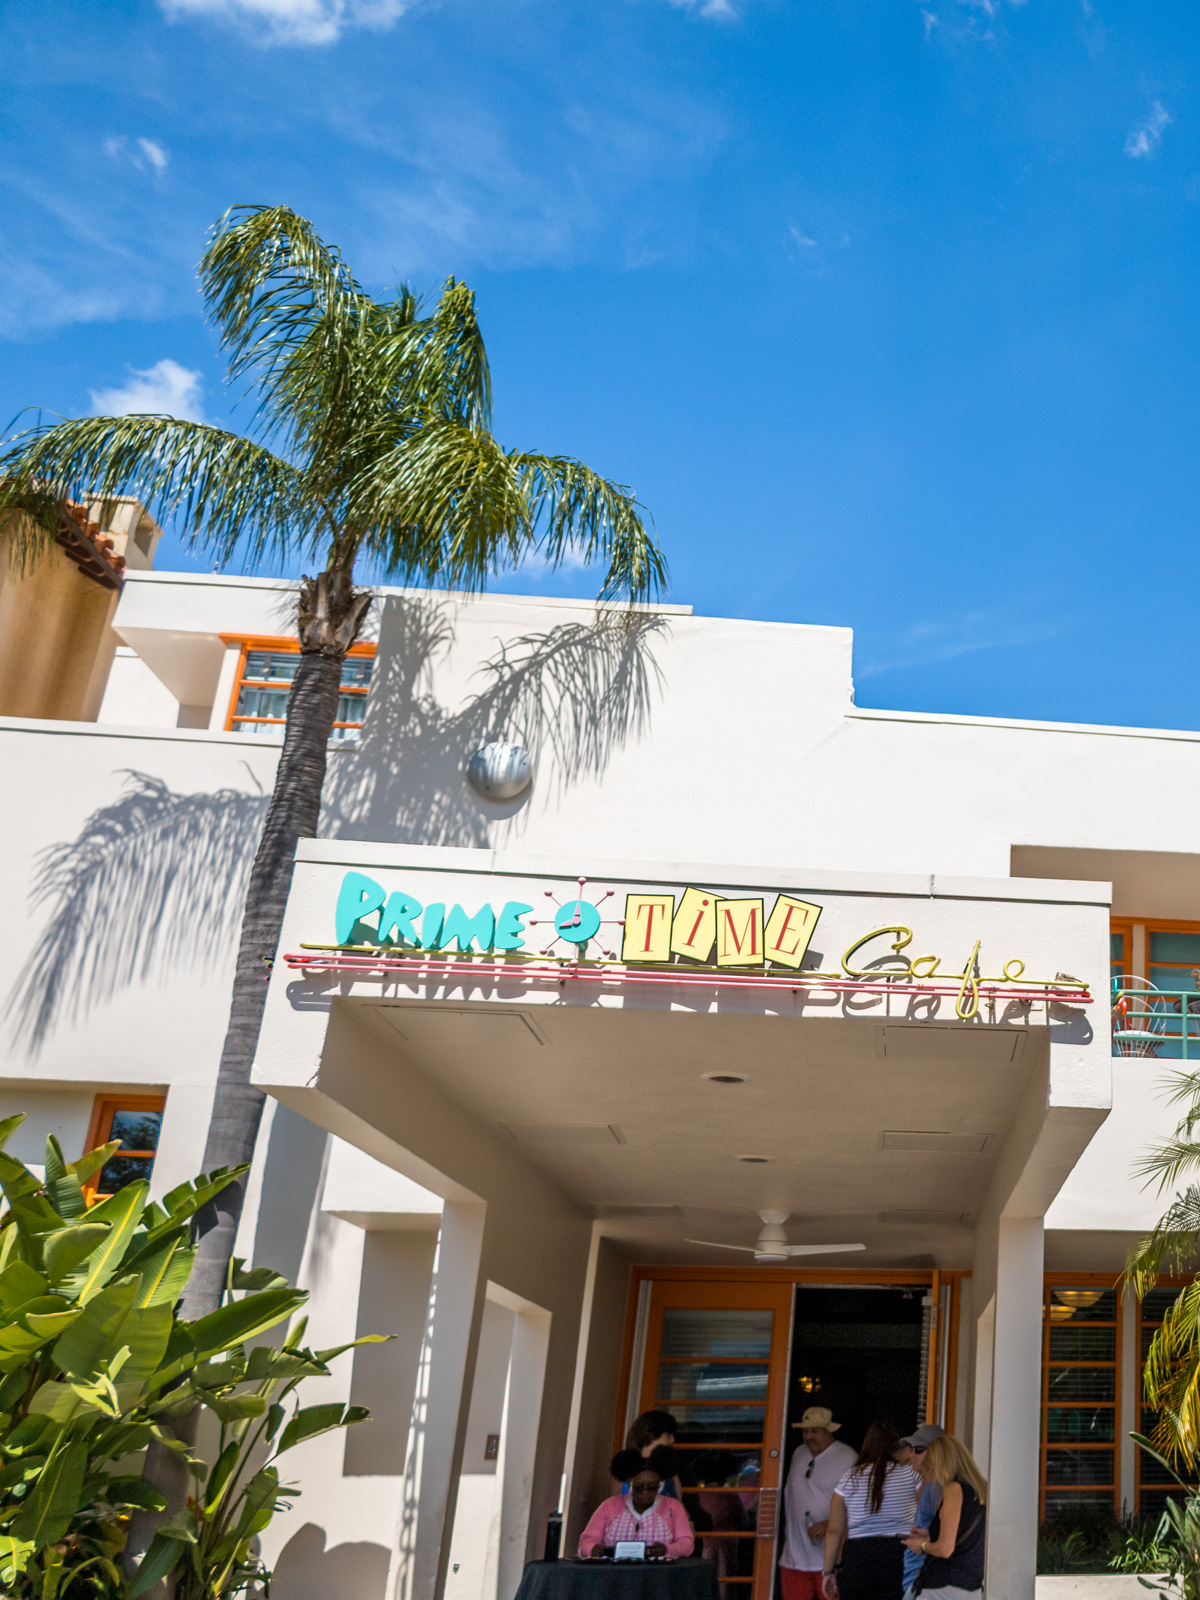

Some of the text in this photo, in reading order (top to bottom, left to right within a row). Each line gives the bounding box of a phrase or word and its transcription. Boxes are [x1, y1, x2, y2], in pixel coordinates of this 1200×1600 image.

[335, 871, 534, 951] PRIME
[841, 925, 1090, 1019] Cafe
[487, 1438, 498, 1457] 4
